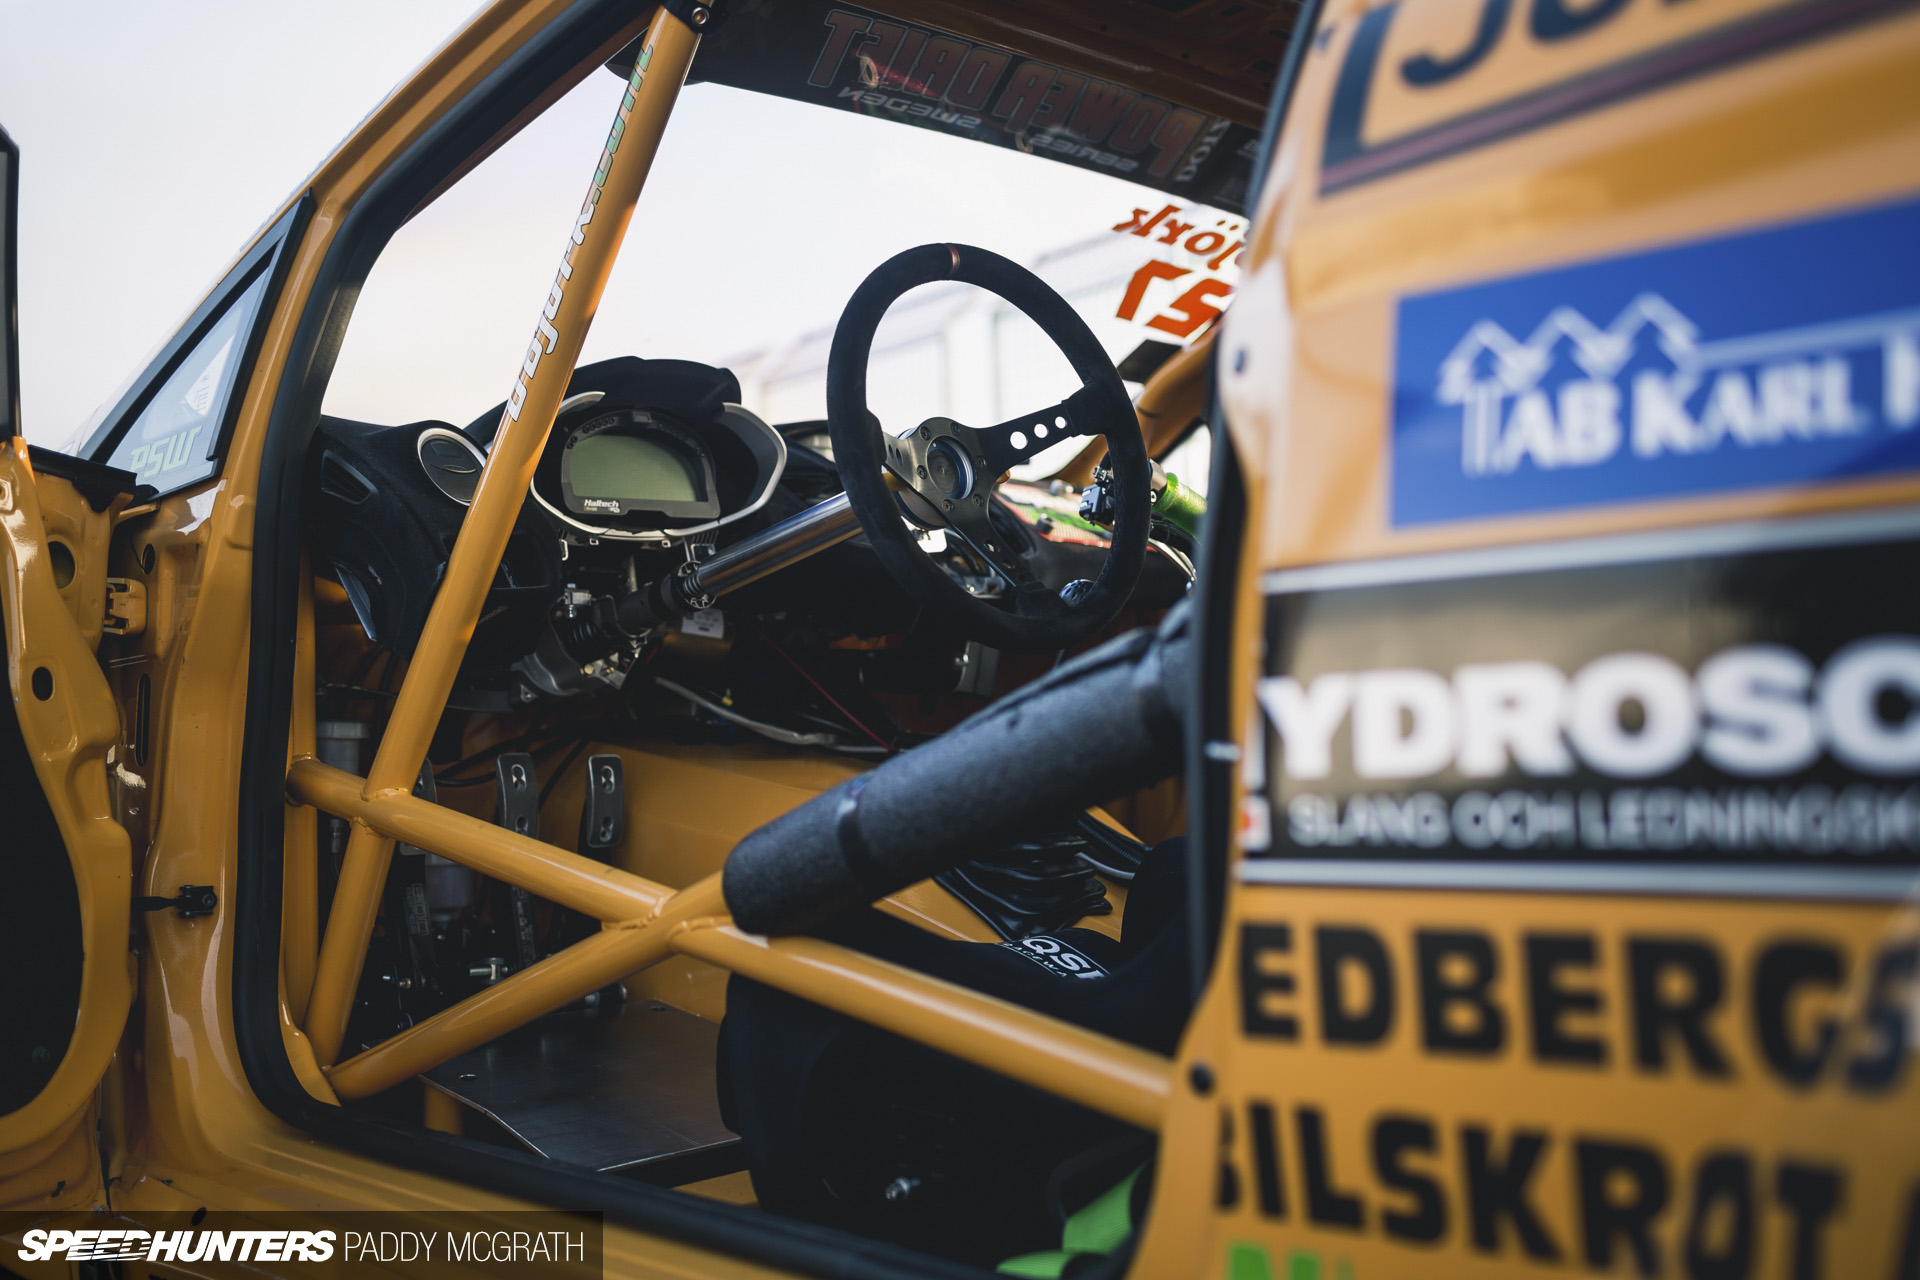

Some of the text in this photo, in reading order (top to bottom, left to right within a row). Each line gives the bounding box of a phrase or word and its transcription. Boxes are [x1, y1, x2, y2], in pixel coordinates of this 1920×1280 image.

[1632, 355, 1869, 457] KARL
[584, 498, 619, 507] Haltech
[1246, 636, 1920, 780] YDROSC
